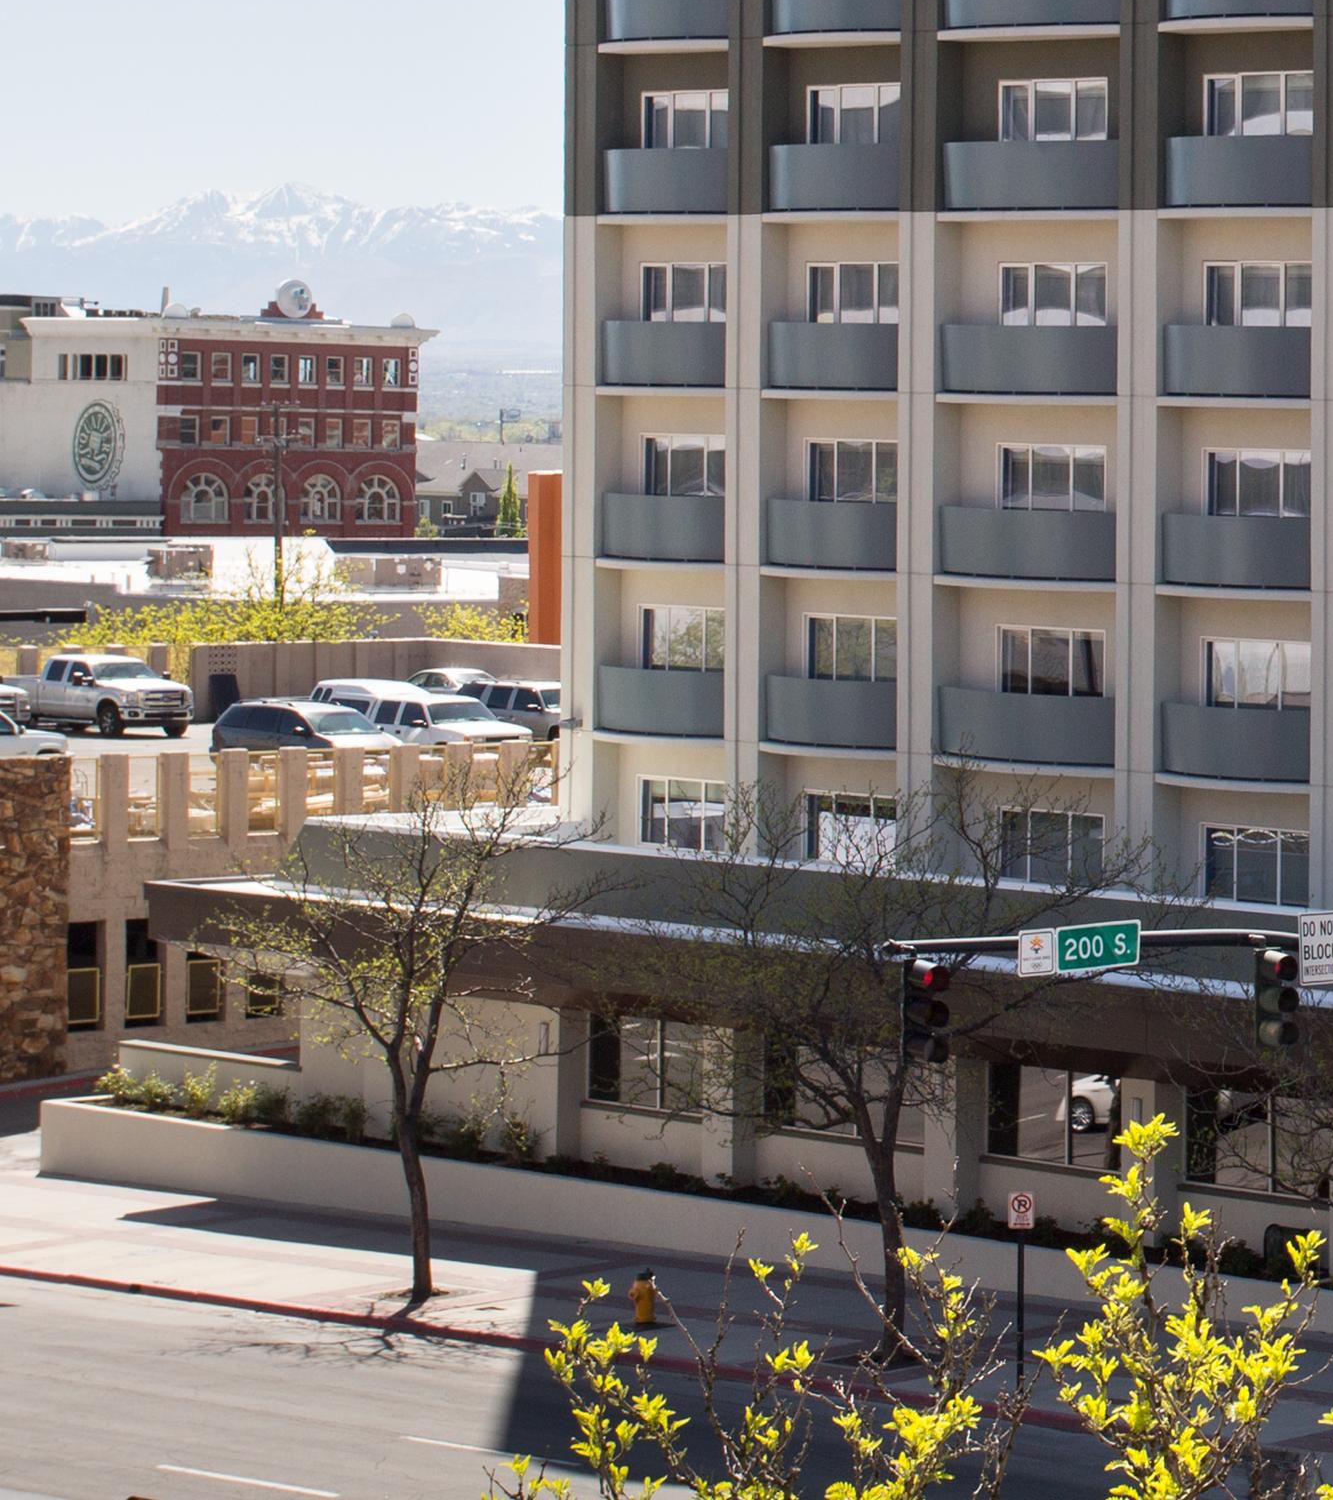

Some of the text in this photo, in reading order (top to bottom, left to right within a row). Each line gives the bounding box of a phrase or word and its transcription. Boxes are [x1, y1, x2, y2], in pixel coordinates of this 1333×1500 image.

[1302, 921, 1316, 938] DO
[1064, 932, 1131, 961] 200 S.
